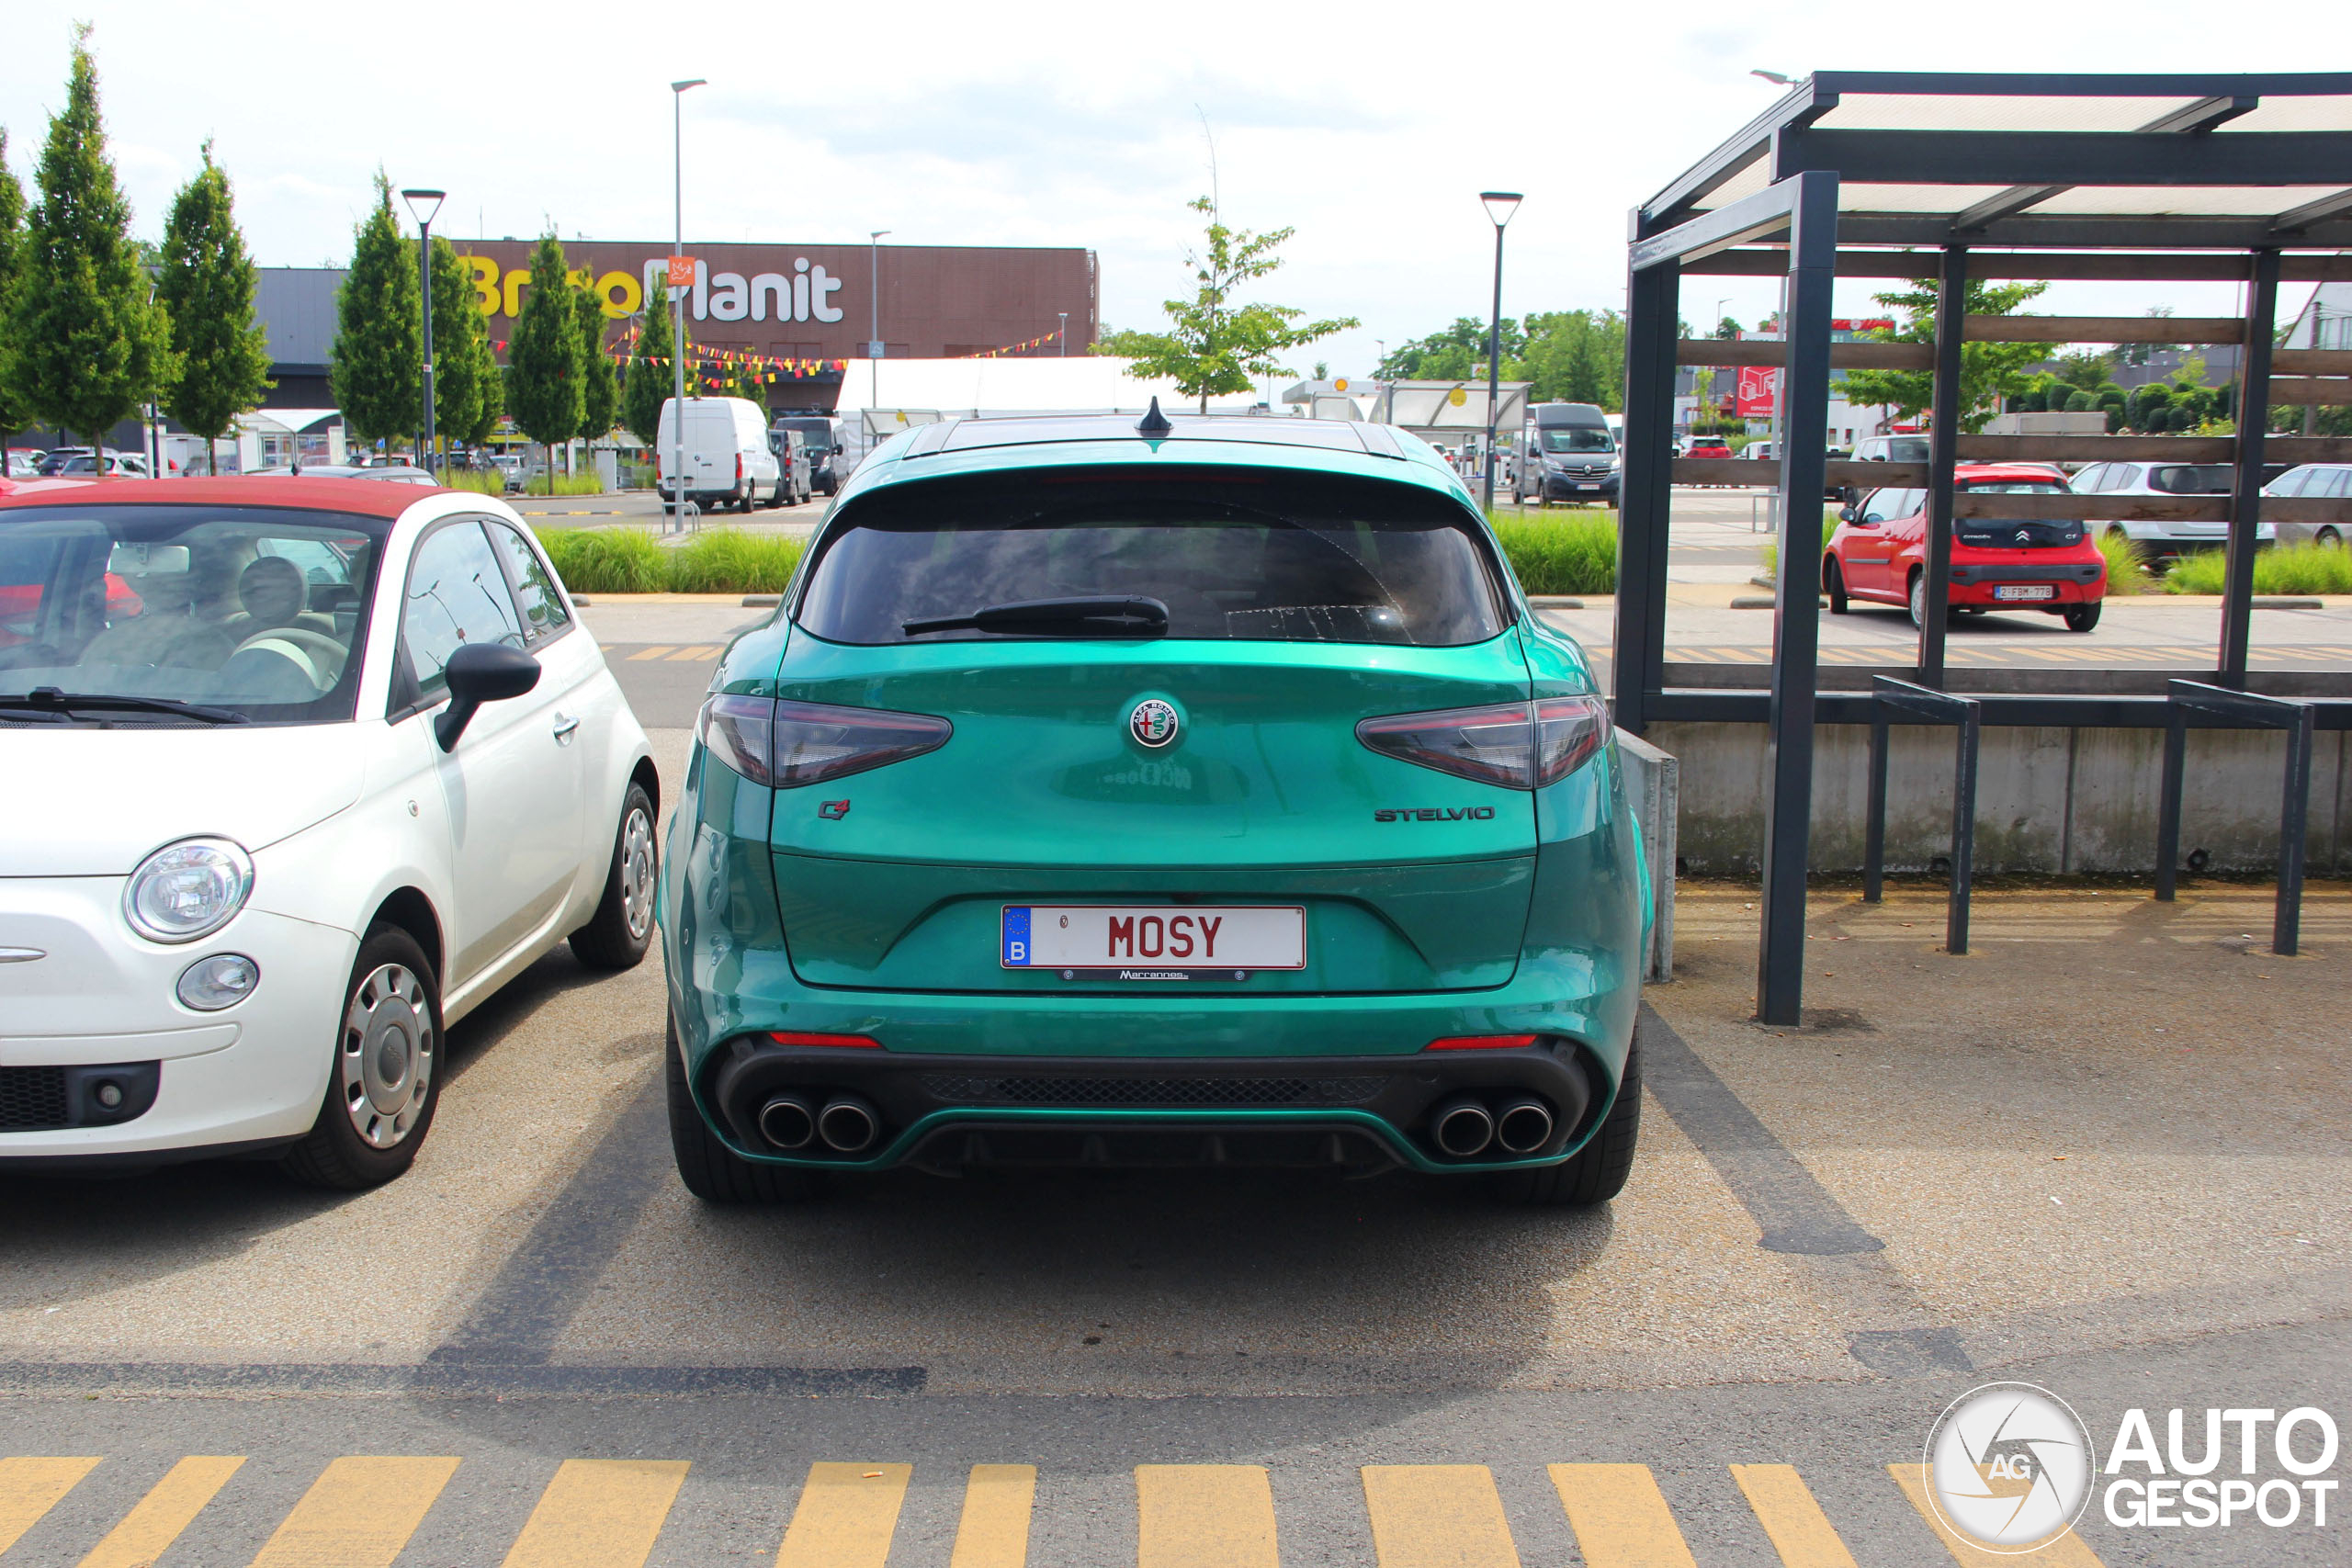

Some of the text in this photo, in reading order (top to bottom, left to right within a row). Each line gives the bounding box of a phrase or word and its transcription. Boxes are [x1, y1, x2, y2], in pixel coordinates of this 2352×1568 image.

[1134, 703, 1175, 725] ALFA ROMEO
[1374, 806, 1495, 822] STELVIO
[1108, 916, 1222, 958] MOSY
[1011, 941, 1025, 961] B
